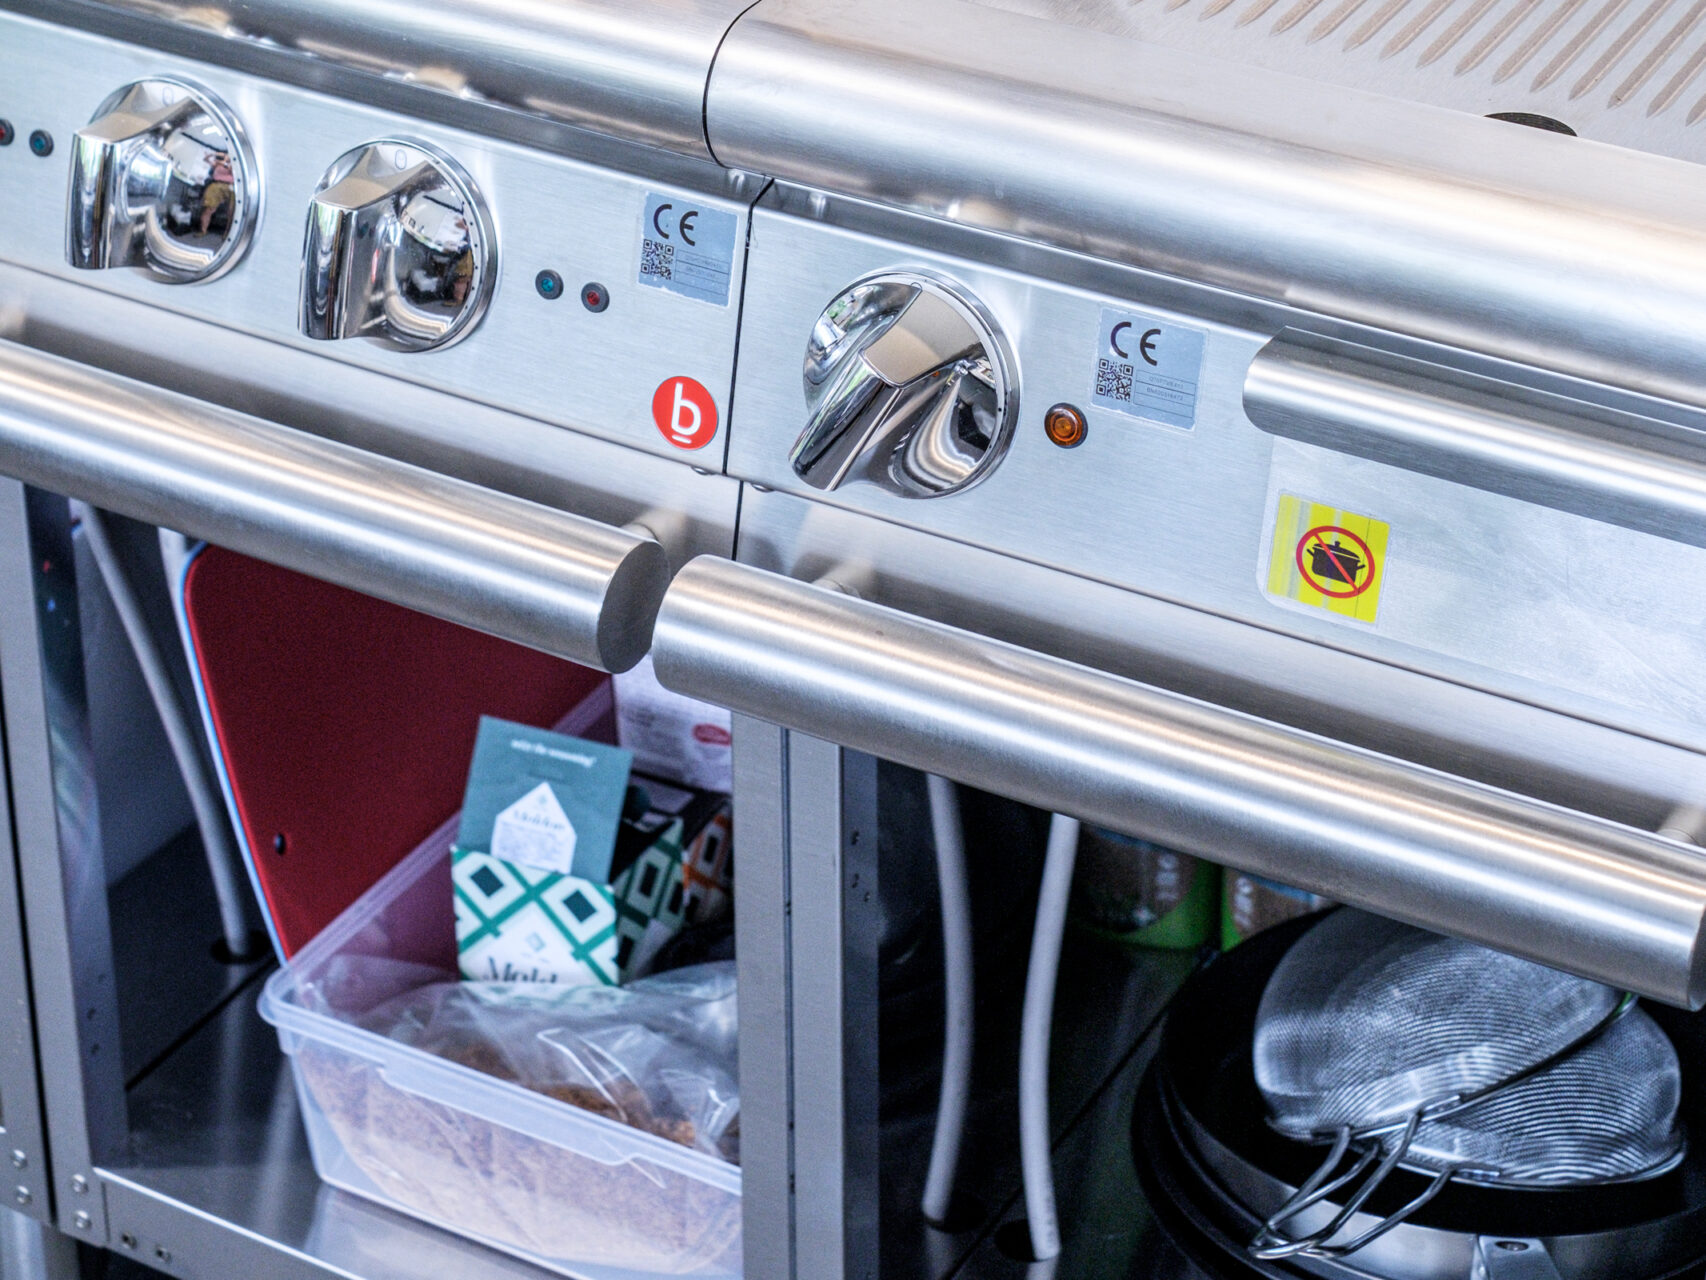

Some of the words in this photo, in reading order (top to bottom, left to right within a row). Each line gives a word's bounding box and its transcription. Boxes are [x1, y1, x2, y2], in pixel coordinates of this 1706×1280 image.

[653, 203, 699, 247] CE
[1110, 321, 1162, 367] CE
[671, 382, 702, 437] b
